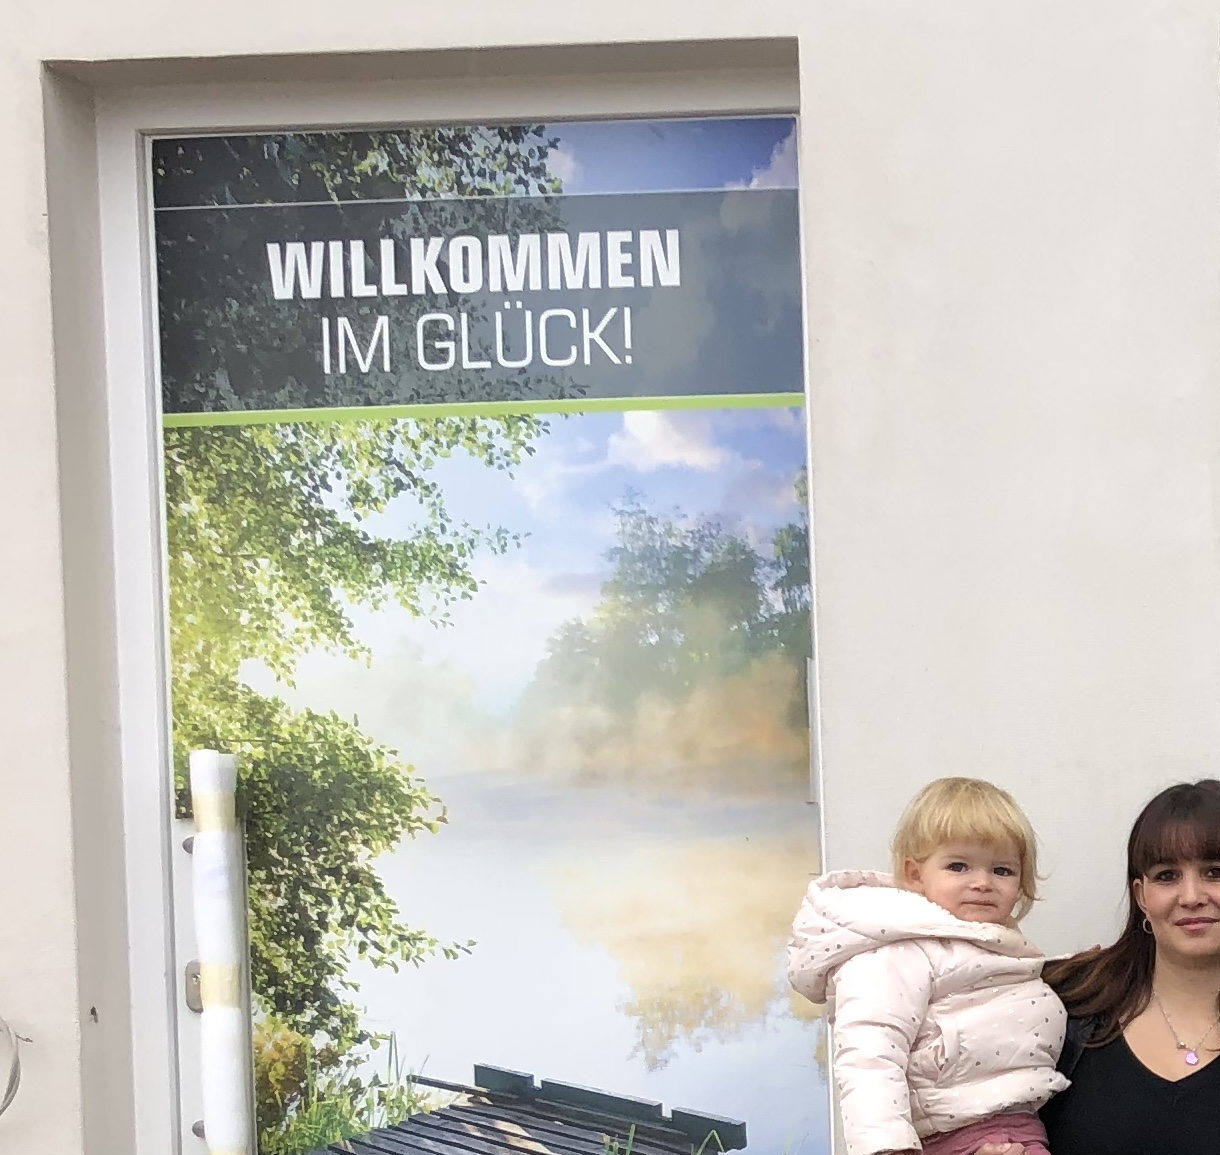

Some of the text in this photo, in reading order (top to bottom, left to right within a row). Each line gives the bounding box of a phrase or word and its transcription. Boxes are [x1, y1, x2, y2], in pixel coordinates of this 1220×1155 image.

[266, 228, 682, 300] WILLKOMMEN
[321, 300, 633, 375] IM GLÜCK!
